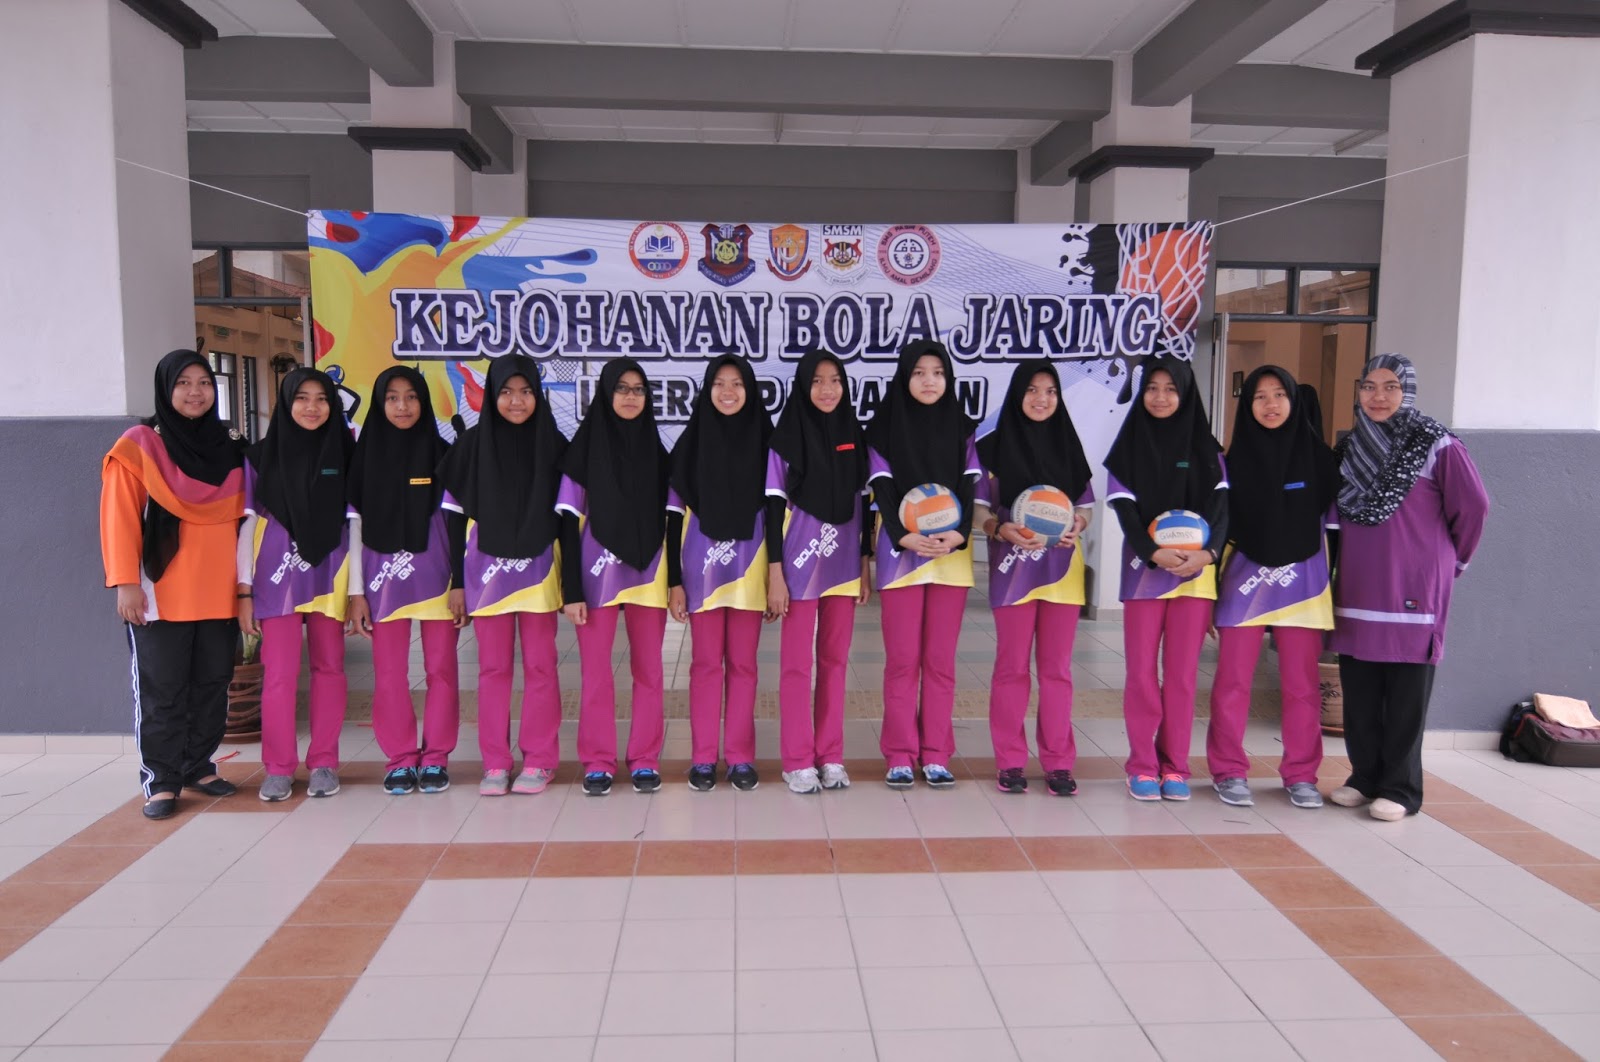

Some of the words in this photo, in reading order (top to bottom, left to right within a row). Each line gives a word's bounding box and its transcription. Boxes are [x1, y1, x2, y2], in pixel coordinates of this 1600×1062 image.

[823, 225, 862, 236] SMSM
[918, 226, 937, 246] PUTEH
[890, 273, 908, 285] AMAL
[391, 289, 770, 360] KEJOHANAN
[779, 291, 942, 362] BOLA
[949, 293, 1161, 361] JARING
[576, 376, 697, 421] IER
[720, 549, 737, 566] GM
[793, 538, 820, 569] BOLA
[823, 540, 839, 557] GM
[369, 561, 391, 592] BOLA
[398, 563, 415, 580] GM
[1279, 570, 1298, 587] GM
[1238, 566, 1270, 596] BOLA
